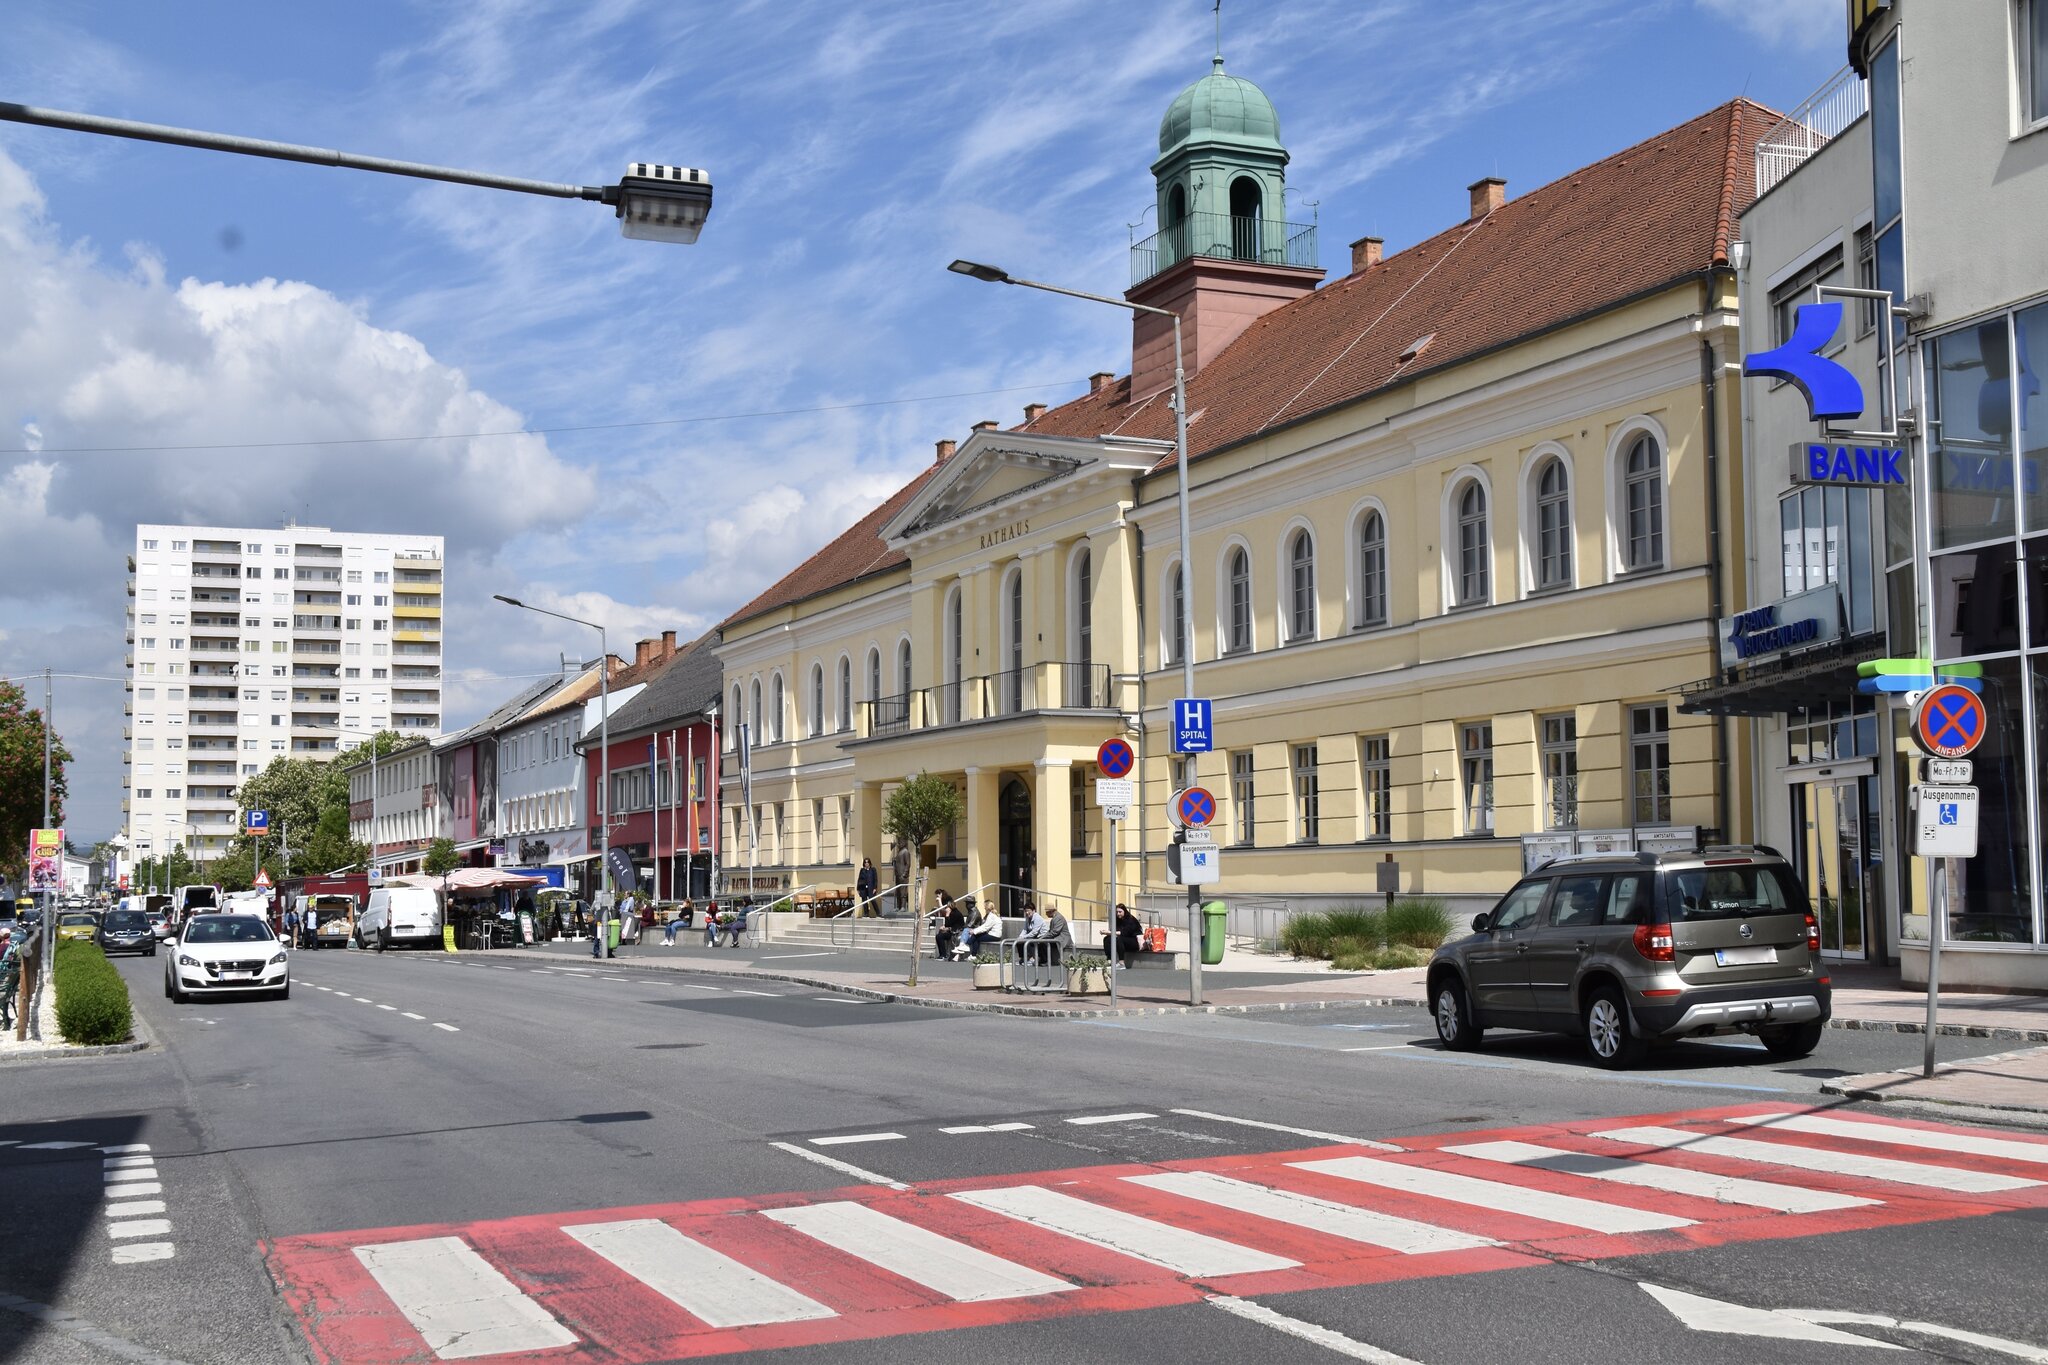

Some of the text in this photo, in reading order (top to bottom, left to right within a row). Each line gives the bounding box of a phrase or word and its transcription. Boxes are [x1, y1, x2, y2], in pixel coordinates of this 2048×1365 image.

[1808, 445, 1905, 485] BANK
[980, 519, 1029, 549] RATHAUS
[1744, 605, 1776, 632] BANK
[1745, 618, 1818, 656] BURGENLAND
[1184, 702, 1203, 729] H
[1180, 730, 1207, 739] SPITAL
[1935, 745, 1967, 756] ANFANG
[1923, 789, 1975, 802] Ausgenommen
[252, 812, 263, 826] P
[1106, 808, 1126, 818] Anfang
[1718, 901, 1739, 909] Simon
